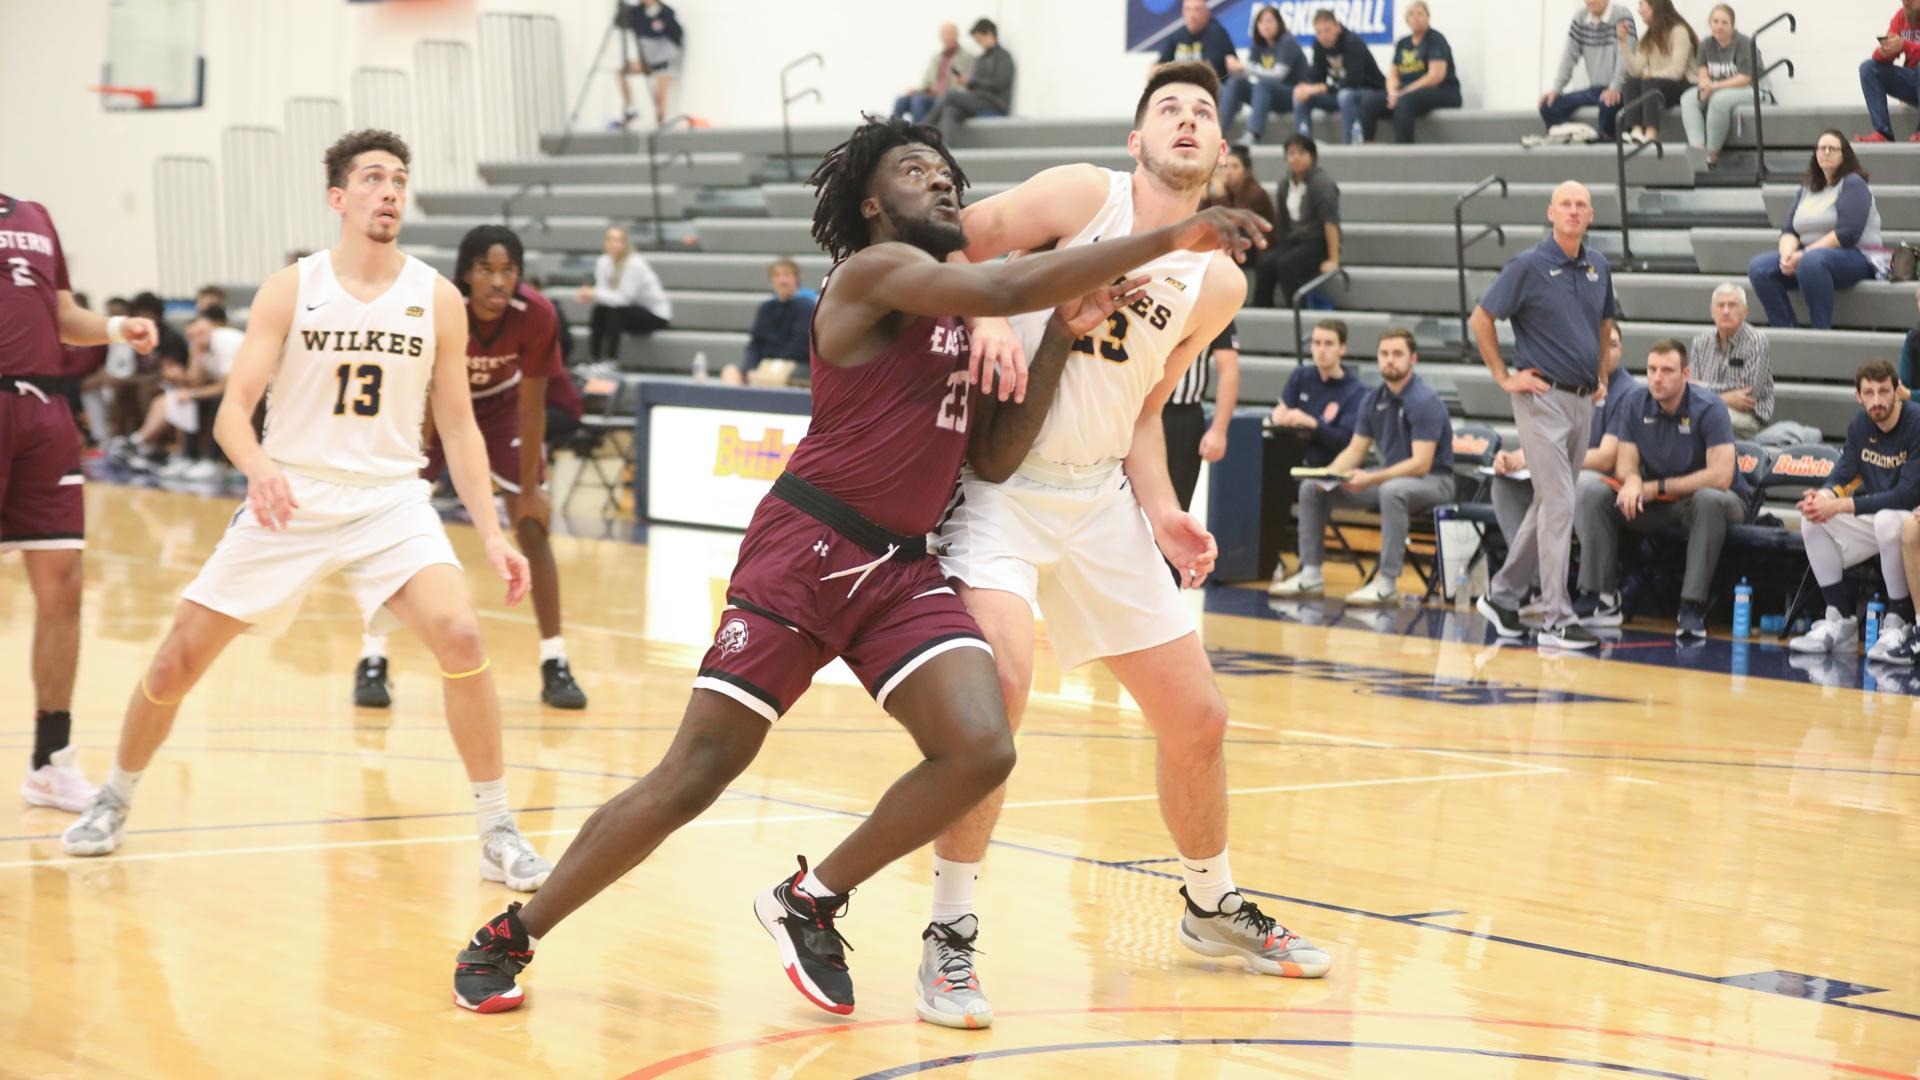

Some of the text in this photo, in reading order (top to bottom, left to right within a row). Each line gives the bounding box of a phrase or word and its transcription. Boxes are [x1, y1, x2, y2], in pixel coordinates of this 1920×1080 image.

[7, 256, 37, 287] 2
[301, 330, 424, 358] WILKES
[333, 363, 383, 417] 13
[935, 370, 969, 434] 23
[1772, 453, 1834, 478] Bullets
